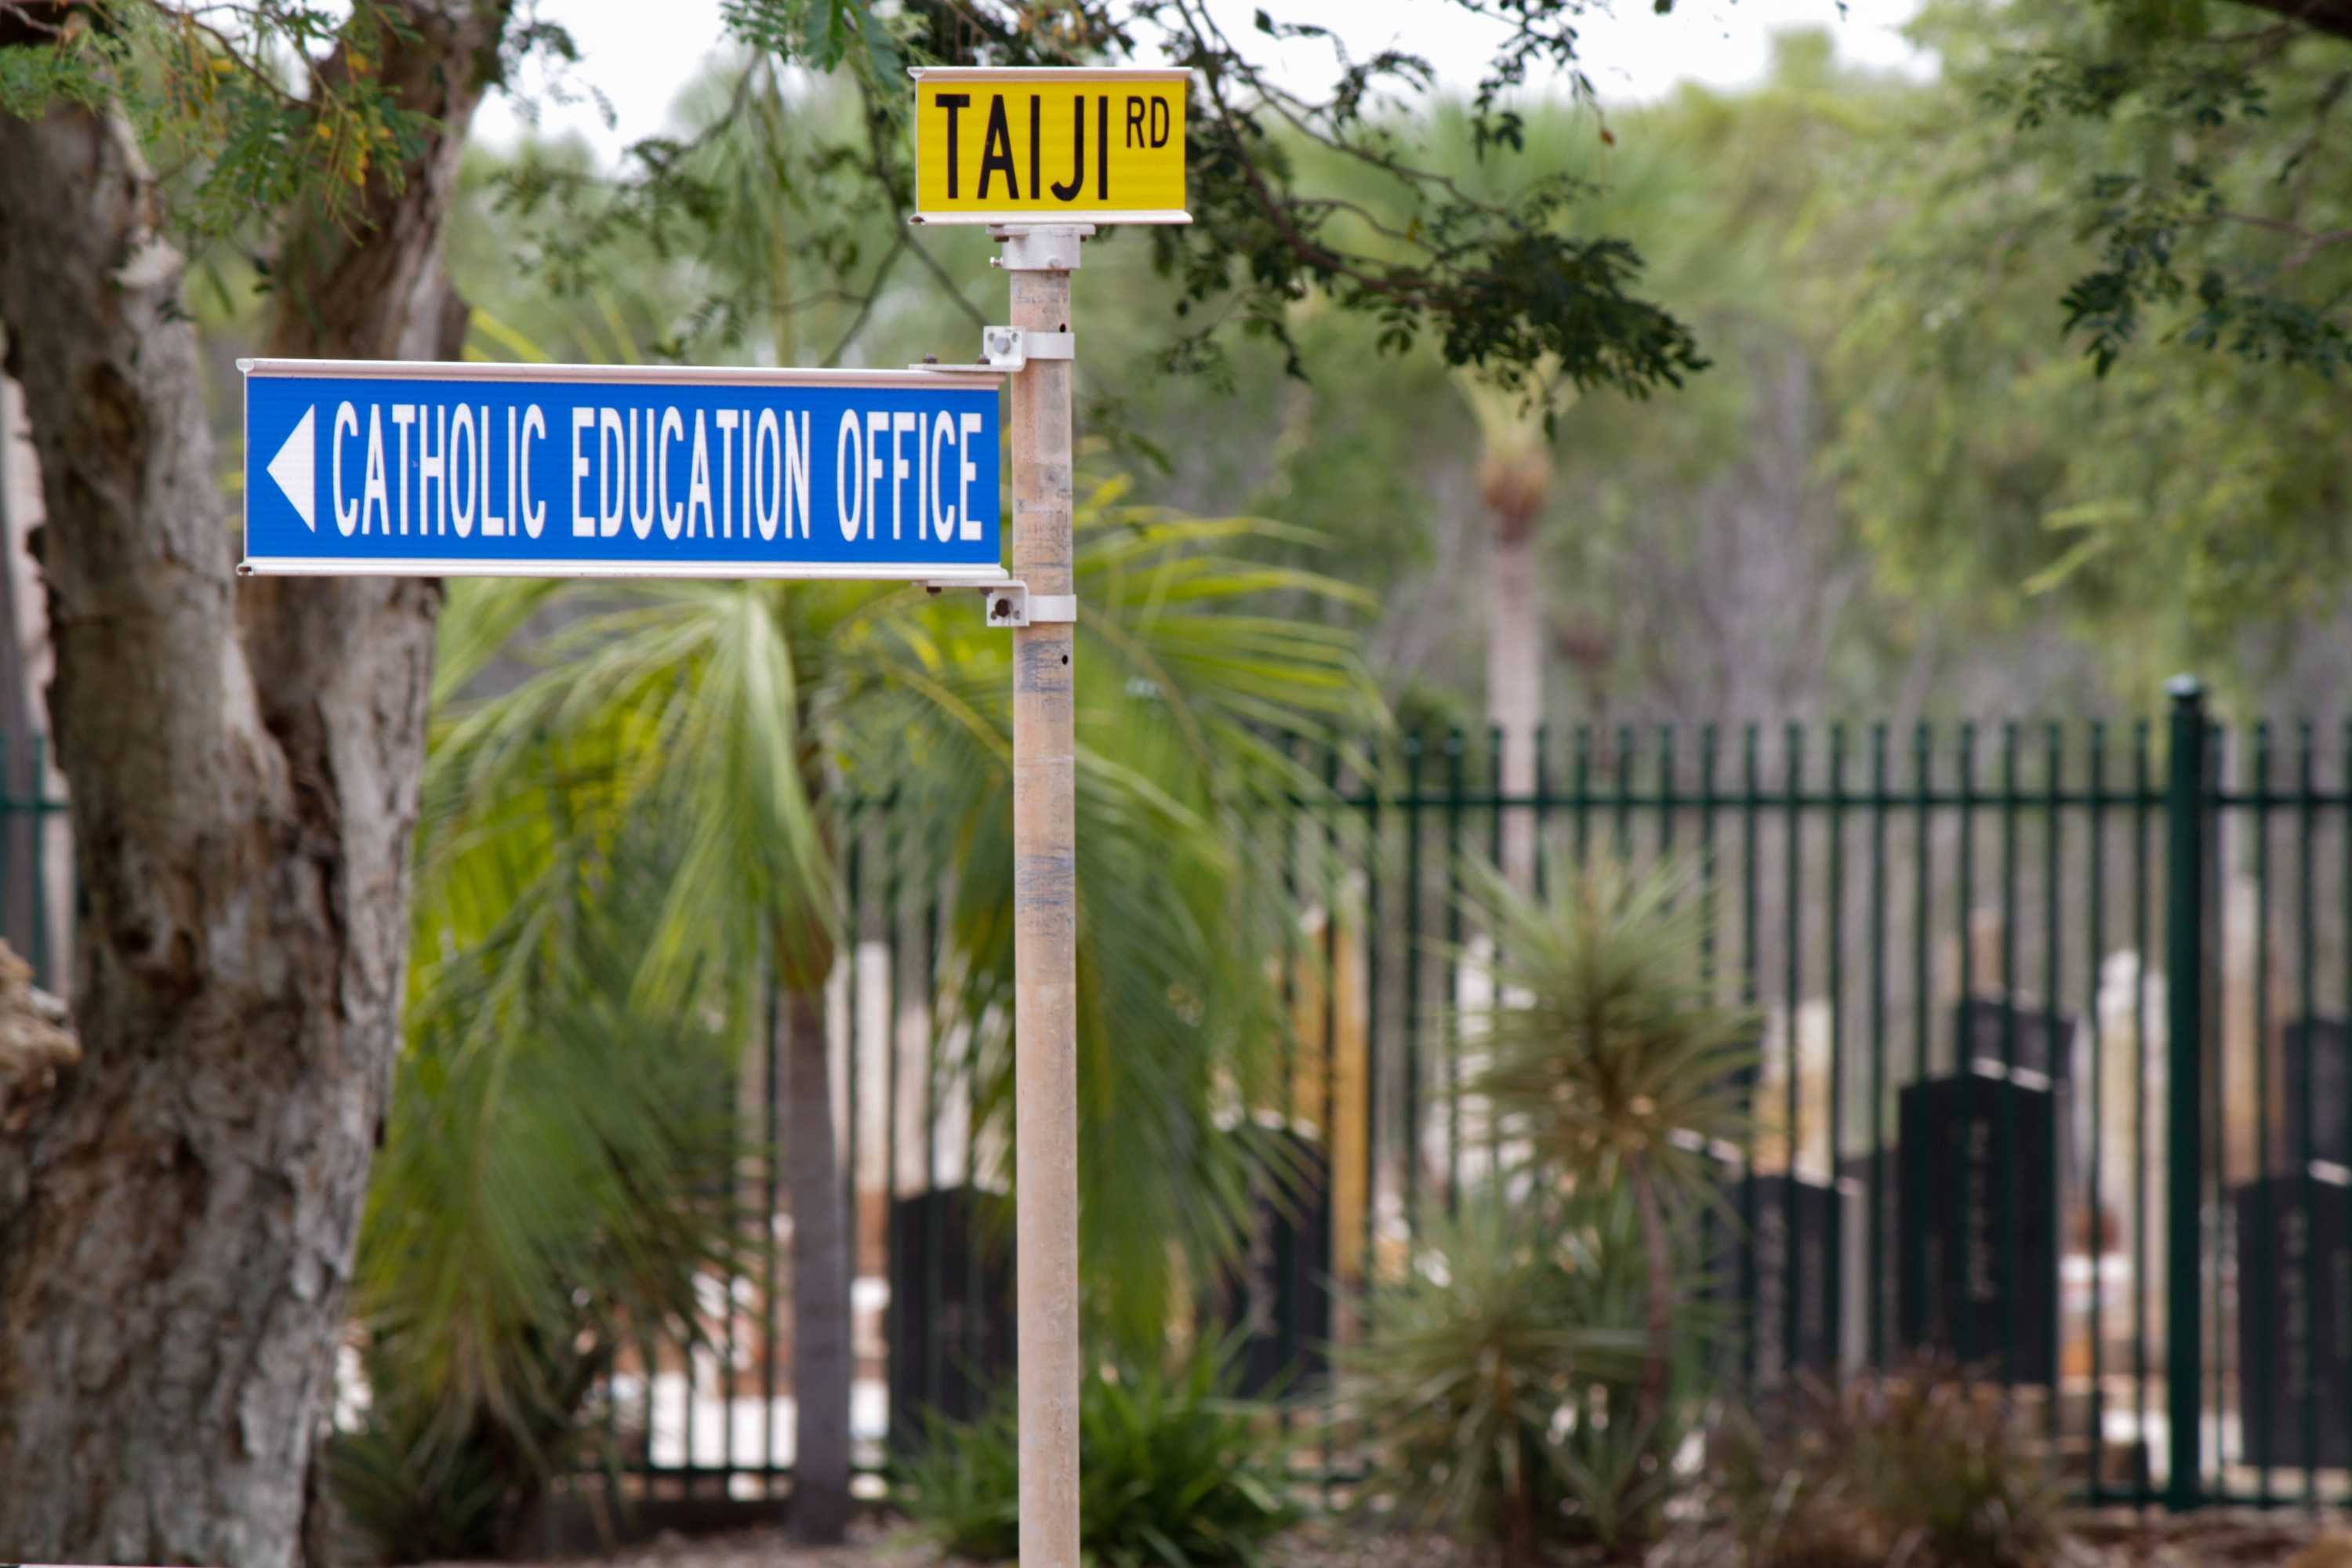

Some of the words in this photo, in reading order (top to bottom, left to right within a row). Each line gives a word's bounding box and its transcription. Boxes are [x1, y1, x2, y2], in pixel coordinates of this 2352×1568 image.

[935, 93, 1108, 201] TAIJI
[1126, 96, 1170, 148] RD
[332, 401, 546, 539] CATHOLIC
[572, 406, 810, 541] EDUCATION
[837, 408, 982, 543] OFFICE
